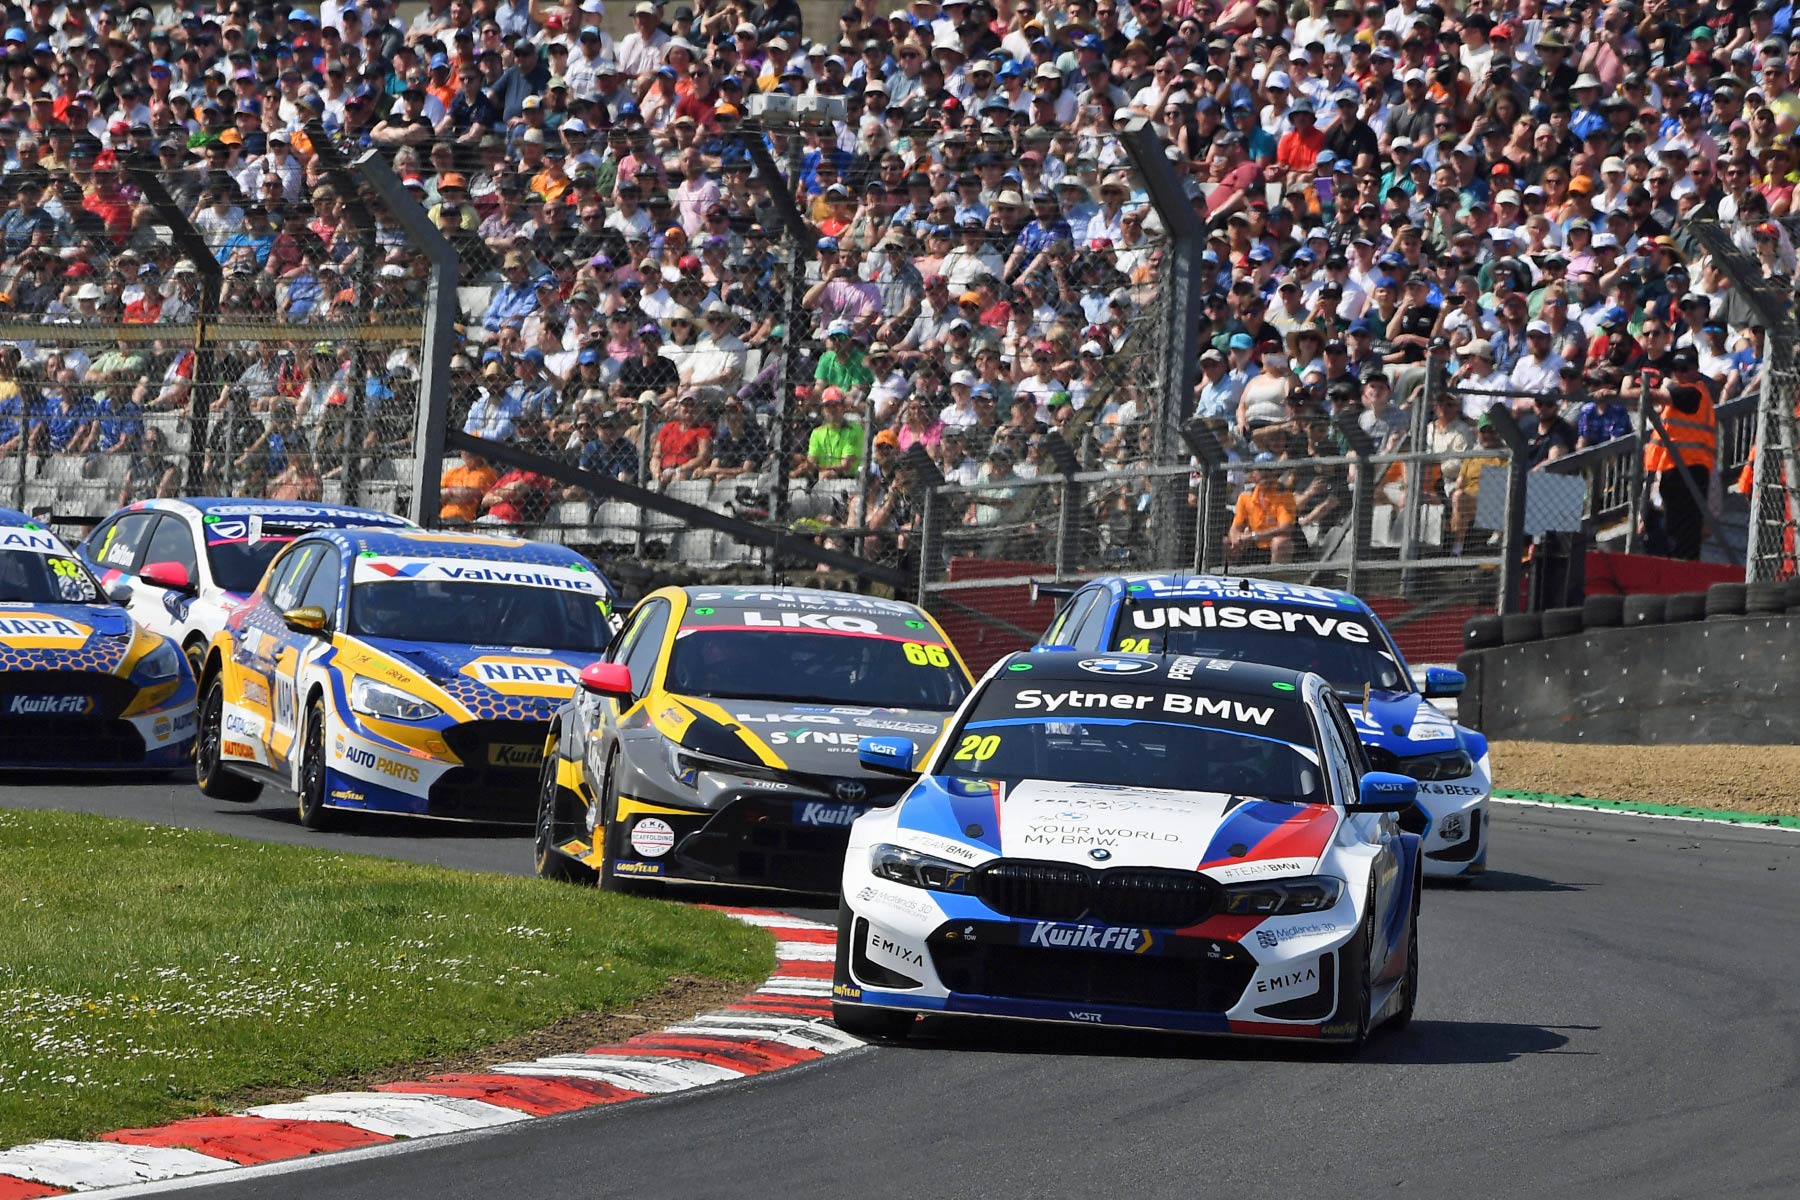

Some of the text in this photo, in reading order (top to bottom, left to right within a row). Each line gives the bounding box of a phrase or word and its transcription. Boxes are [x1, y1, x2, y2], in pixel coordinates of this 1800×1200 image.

[48, 558, 82, 578] 32
[439, 566, 592, 591] Valvoline
[1212, 589, 1279, 601] TOOLS
[743, 611, 883, 636] LKQ
[1120, 638, 1151, 653] 24
[903, 642, 949, 668] 66
[482, 664, 578, 684] NAPA
[1015, 689, 1275, 726] Sytner BMW
[736, 713, 845, 724] LKQ
[869, 742, 897, 756] WSR
[953, 735, 1001, 760] 20
[346, 746, 376, 768] AUTO
[376, 757, 420, 783] PARTS
[752, 782, 788, 790] TRIO
[1373, 783, 1404, 791] WSR
[1444, 784, 1484, 796] BEER
[802, 802, 861, 826] Kwik
[1025, 834, 1120, 847] My BMW.
[1029, 825, 1183, 843] YOUR WORLD.
[616, 862, 659, 873] GOODYEAR
[1225, 862, 1300, 879] #TEAMBMW
[871, 935, 923, 967] EMIXA
[1257, 969, 1316, 992] EMIXA
[834, 984, 861, 998] OODYEAR
[1069, 1012, 1103, 1022] WSR
